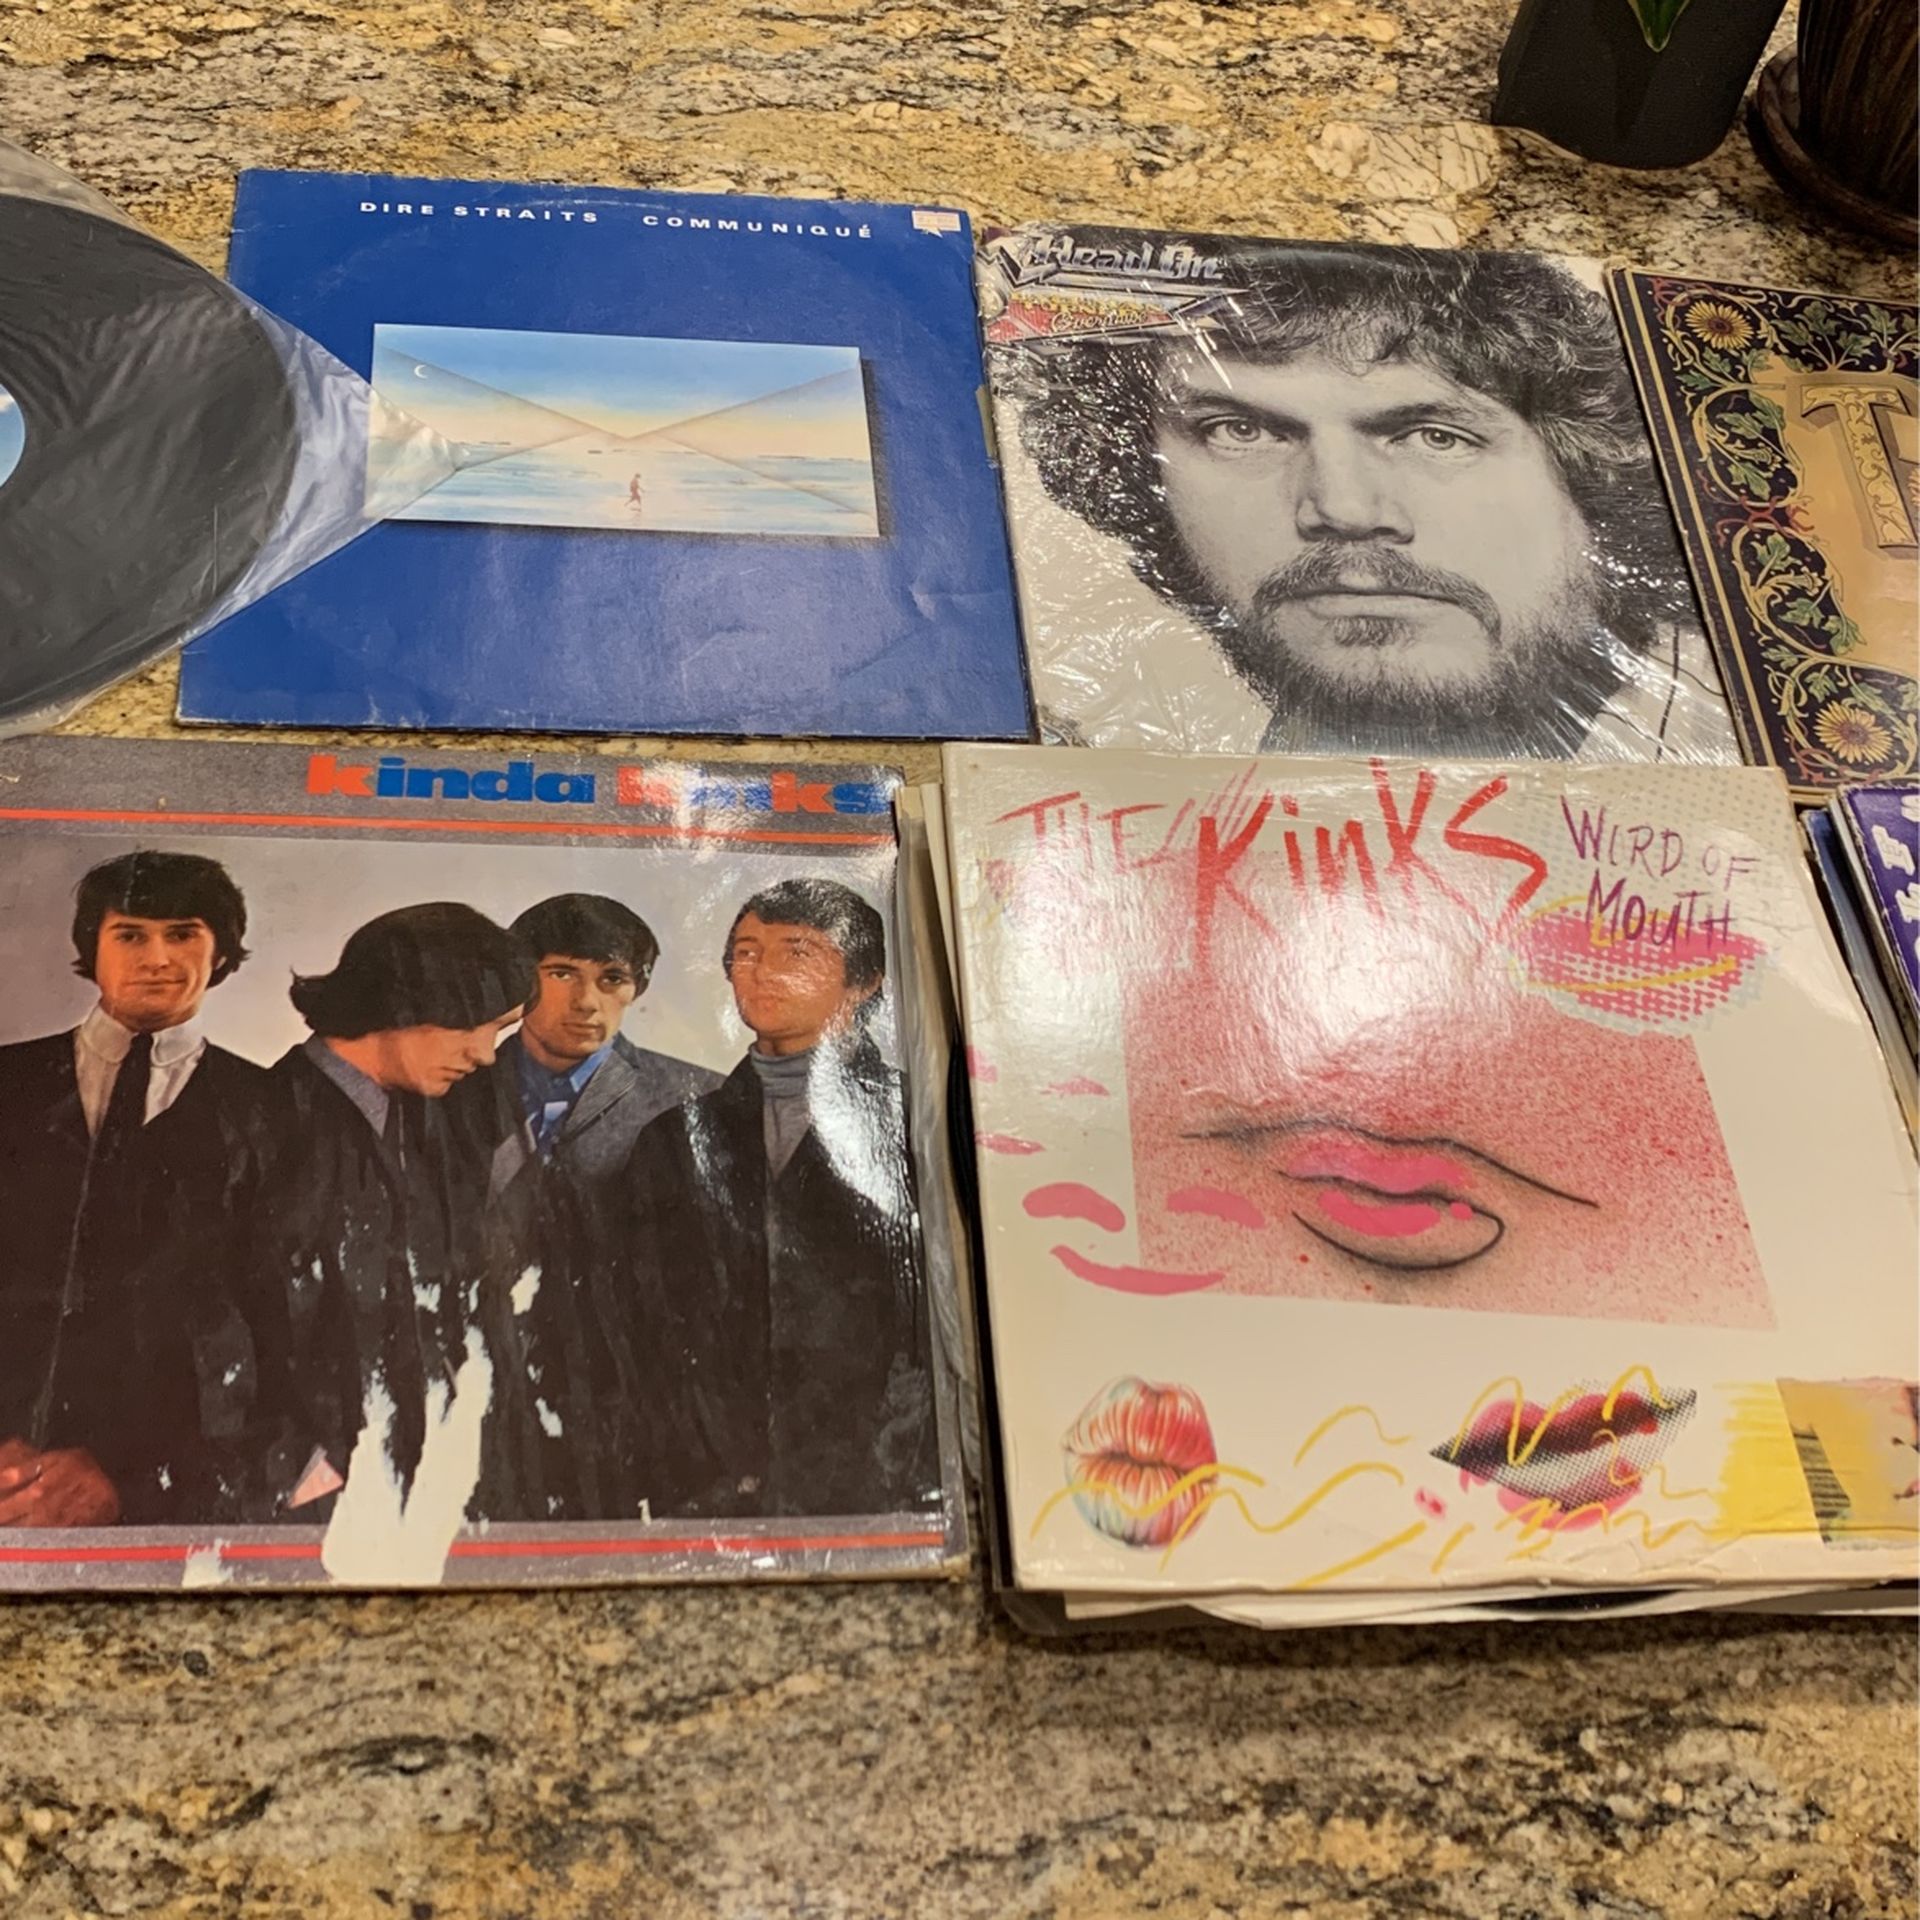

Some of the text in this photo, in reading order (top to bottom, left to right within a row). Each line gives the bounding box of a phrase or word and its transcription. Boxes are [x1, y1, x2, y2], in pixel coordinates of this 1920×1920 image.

[359, 201, 872, 238] DIRE STRAITS COMMUNIQUÉ
[1020, 234, 1152, 276] Head
[306, 753, 594, 804] kinda
[1701, 844, 1762, 892] OF
[1585, 866, 1738, 951] MOUTH
